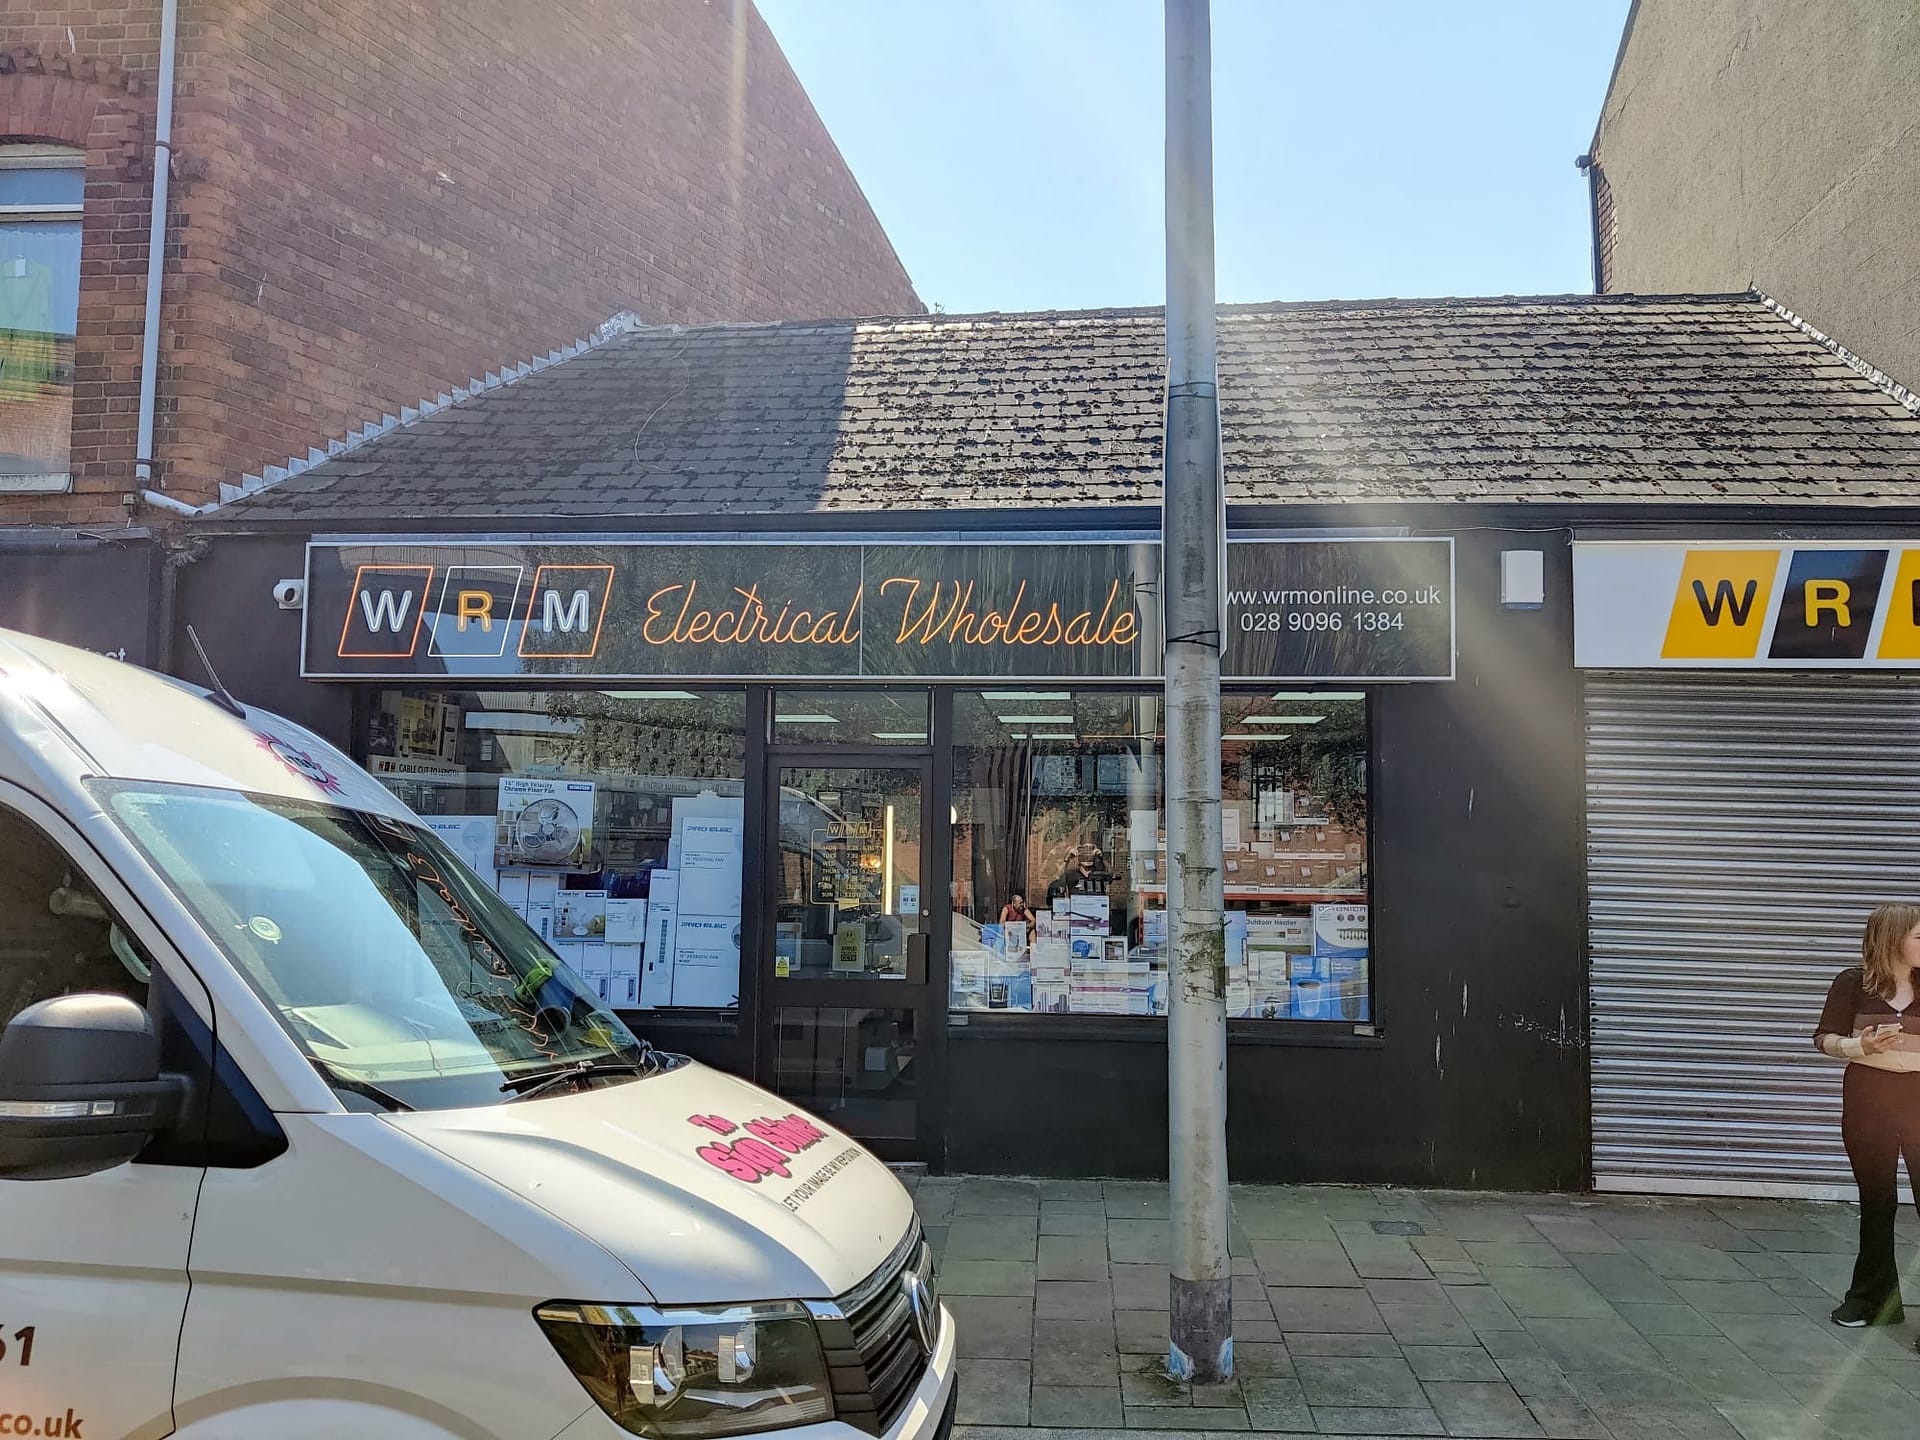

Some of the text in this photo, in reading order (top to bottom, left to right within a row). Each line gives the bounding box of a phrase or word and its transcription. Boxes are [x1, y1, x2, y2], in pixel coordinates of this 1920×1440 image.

[1226, 586, 1441, 605] ww.wrmonline.co.uk
[1692, 579, 1920, 627] WR
[642, 579, 863, 645] Electrical
[880, 577, 1139, 646] Wholesale
[1240, 612, 1404, 631] 028 9096 1384
[695, 1137, 793, 1183] Sign
[780, 1195, 801, 1212] LET
[790, 1183, 817, 1203] YOUR
[0, 1324, 35, 1366] 1
